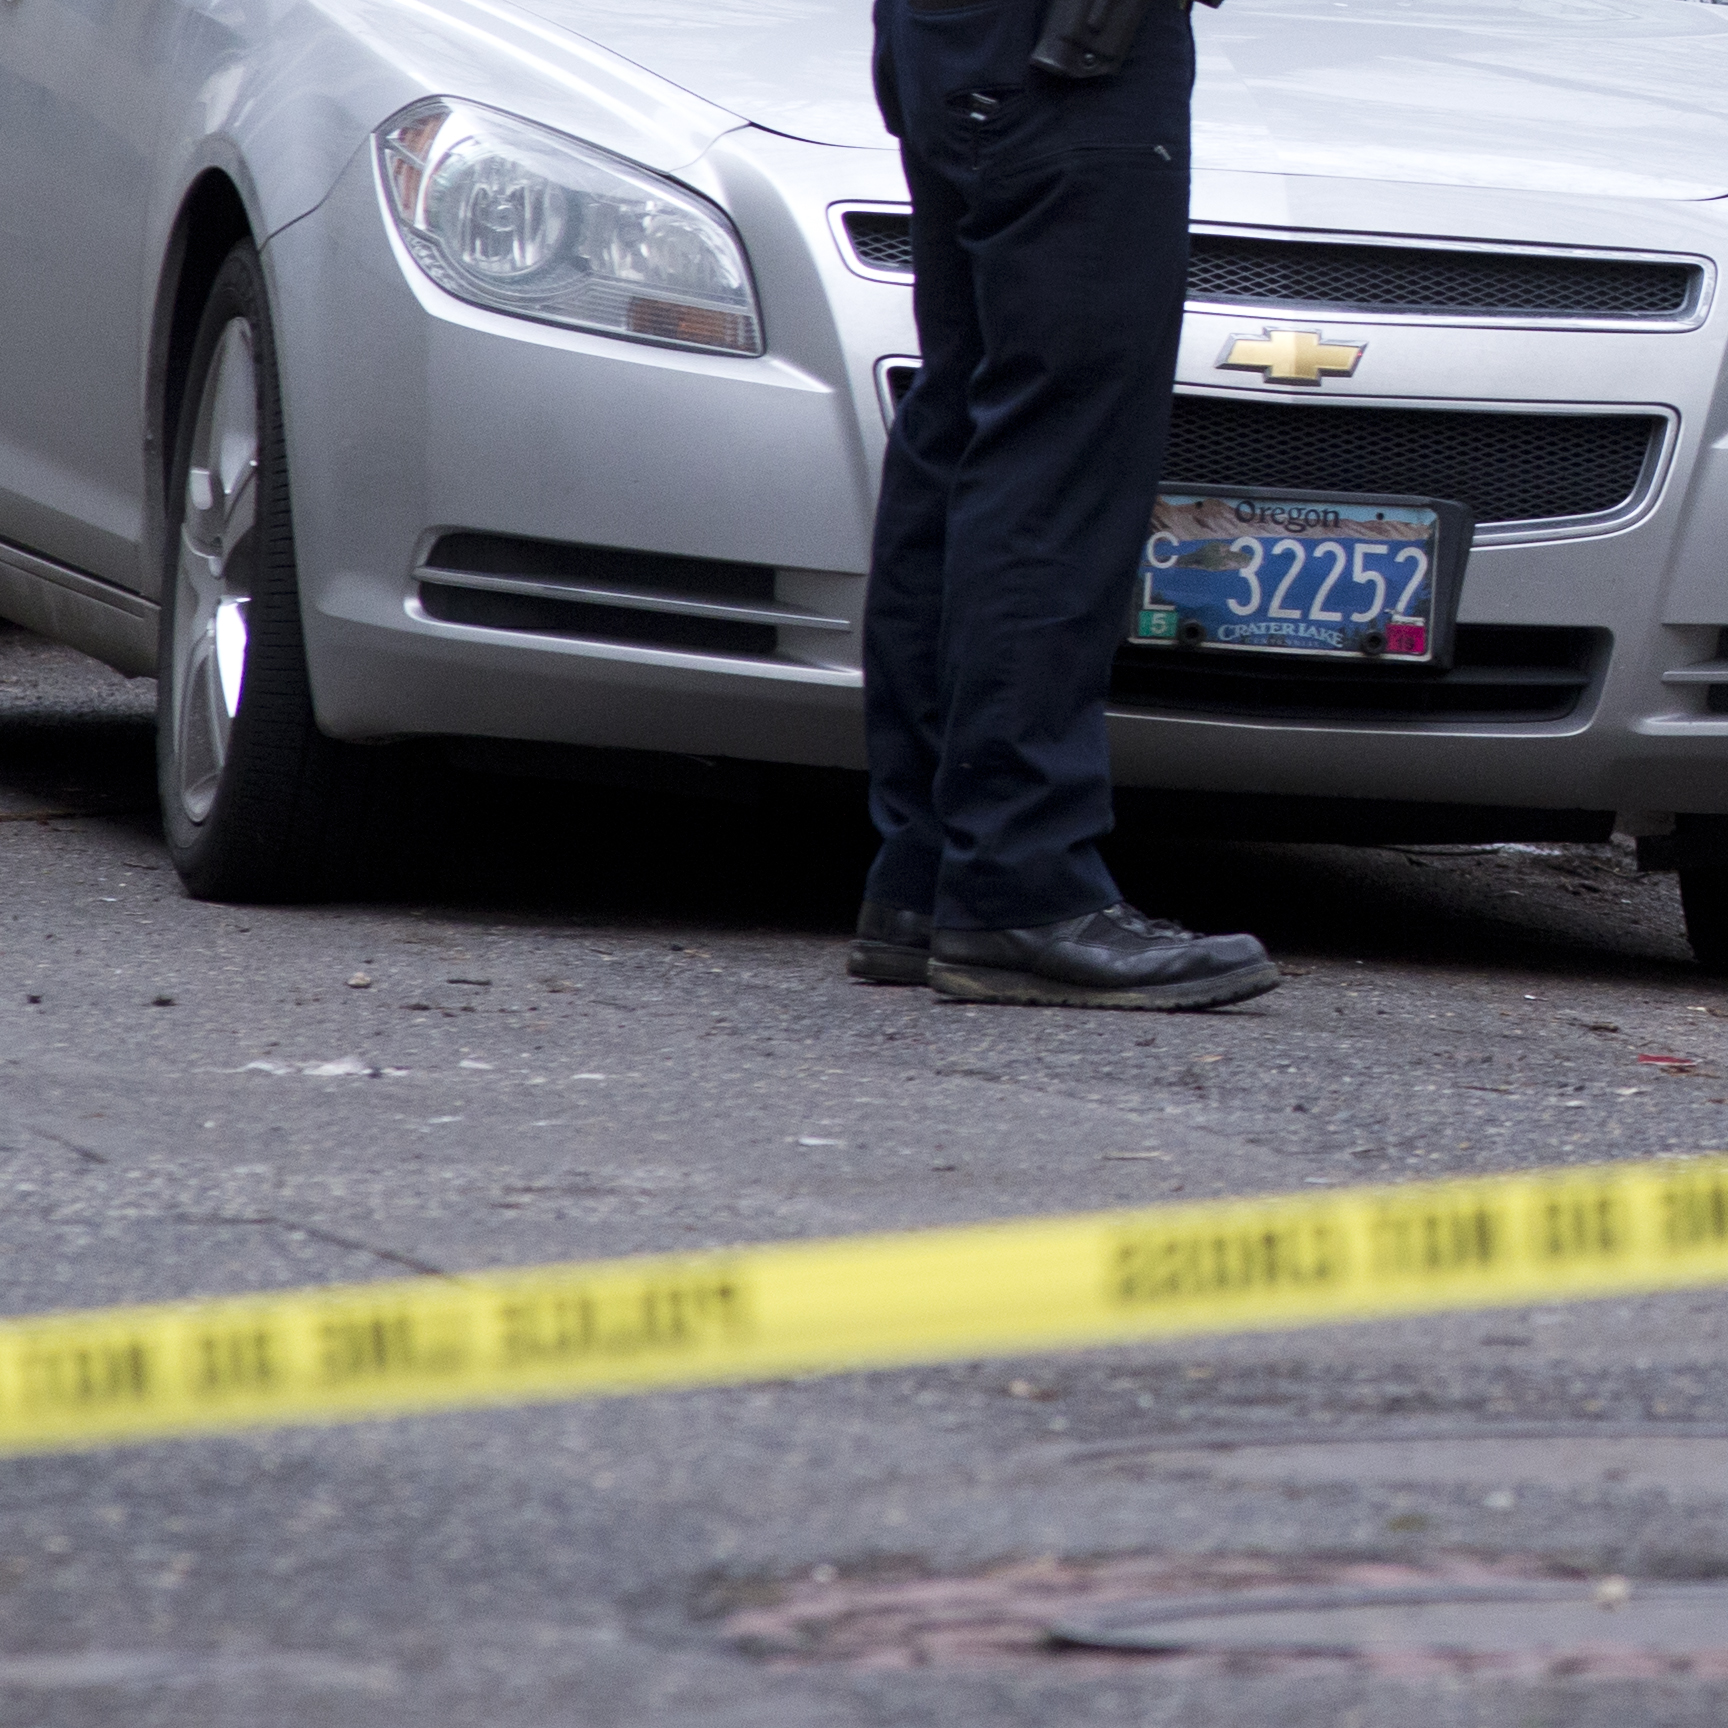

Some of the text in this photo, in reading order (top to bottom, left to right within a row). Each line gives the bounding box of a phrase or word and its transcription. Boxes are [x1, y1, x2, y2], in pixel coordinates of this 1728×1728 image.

[1234, 499, 1341, 533] Oregon
[1227, 536, 1429, 626] 32252
[1150, 614, 1167, 635] 5
[1218, 622, 1344, 648] CRATER LAKE
